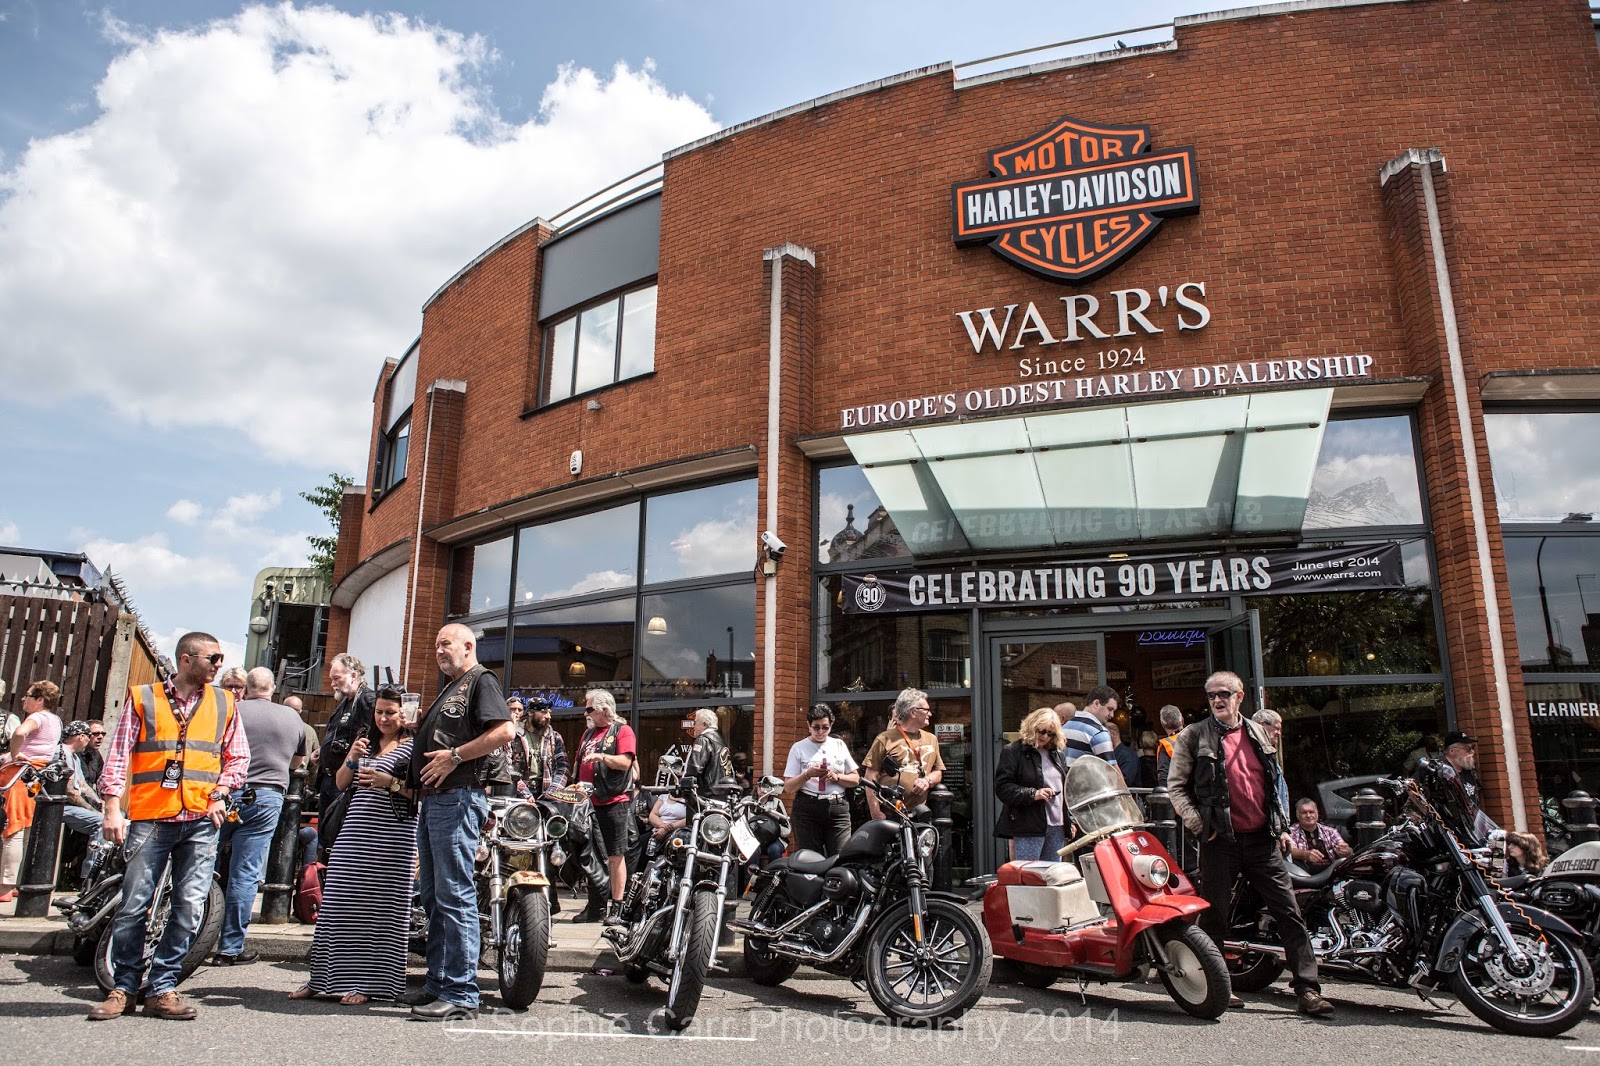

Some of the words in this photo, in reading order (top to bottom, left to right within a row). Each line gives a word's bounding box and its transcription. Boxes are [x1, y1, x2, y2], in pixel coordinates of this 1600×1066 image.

[1014, 130, 1123, 174] MOTOR
[967, 161, 1181, 226] HARLEY-DAVIDSON
[1020, 214, 1133, 265] CYCLES
[957, 281, 1211, 354] WARR'S
[1019, 352, 1086, 378] Since
[1097, 347, 1147, 371] 1924
[842, 393, 957, 428] EUROPE'S
[964, 380, 1067, 411] OLDEST
[1075, 369, 1183, 400] HARLEY
[1193, 354, 1373, 388] DEALERSHIP
[908, 565, 1106, 606] CELEBRATING
[1118, 562, 1157, 597] 90
[1168, 556, 1272, 593] YEARS
[1291, 561, 1324, 571] June
[1328, 560, 1344, 568] 1st
[1347, 557, 1380, 567] 2014
[1292, 570, 1381, 581] www.warrs.com
[862, 587, 879, 604] 90
[1528, 702, 1600, 717] LEARNER
[1551, 858, 1600, 873] FORTY-EIGHT
